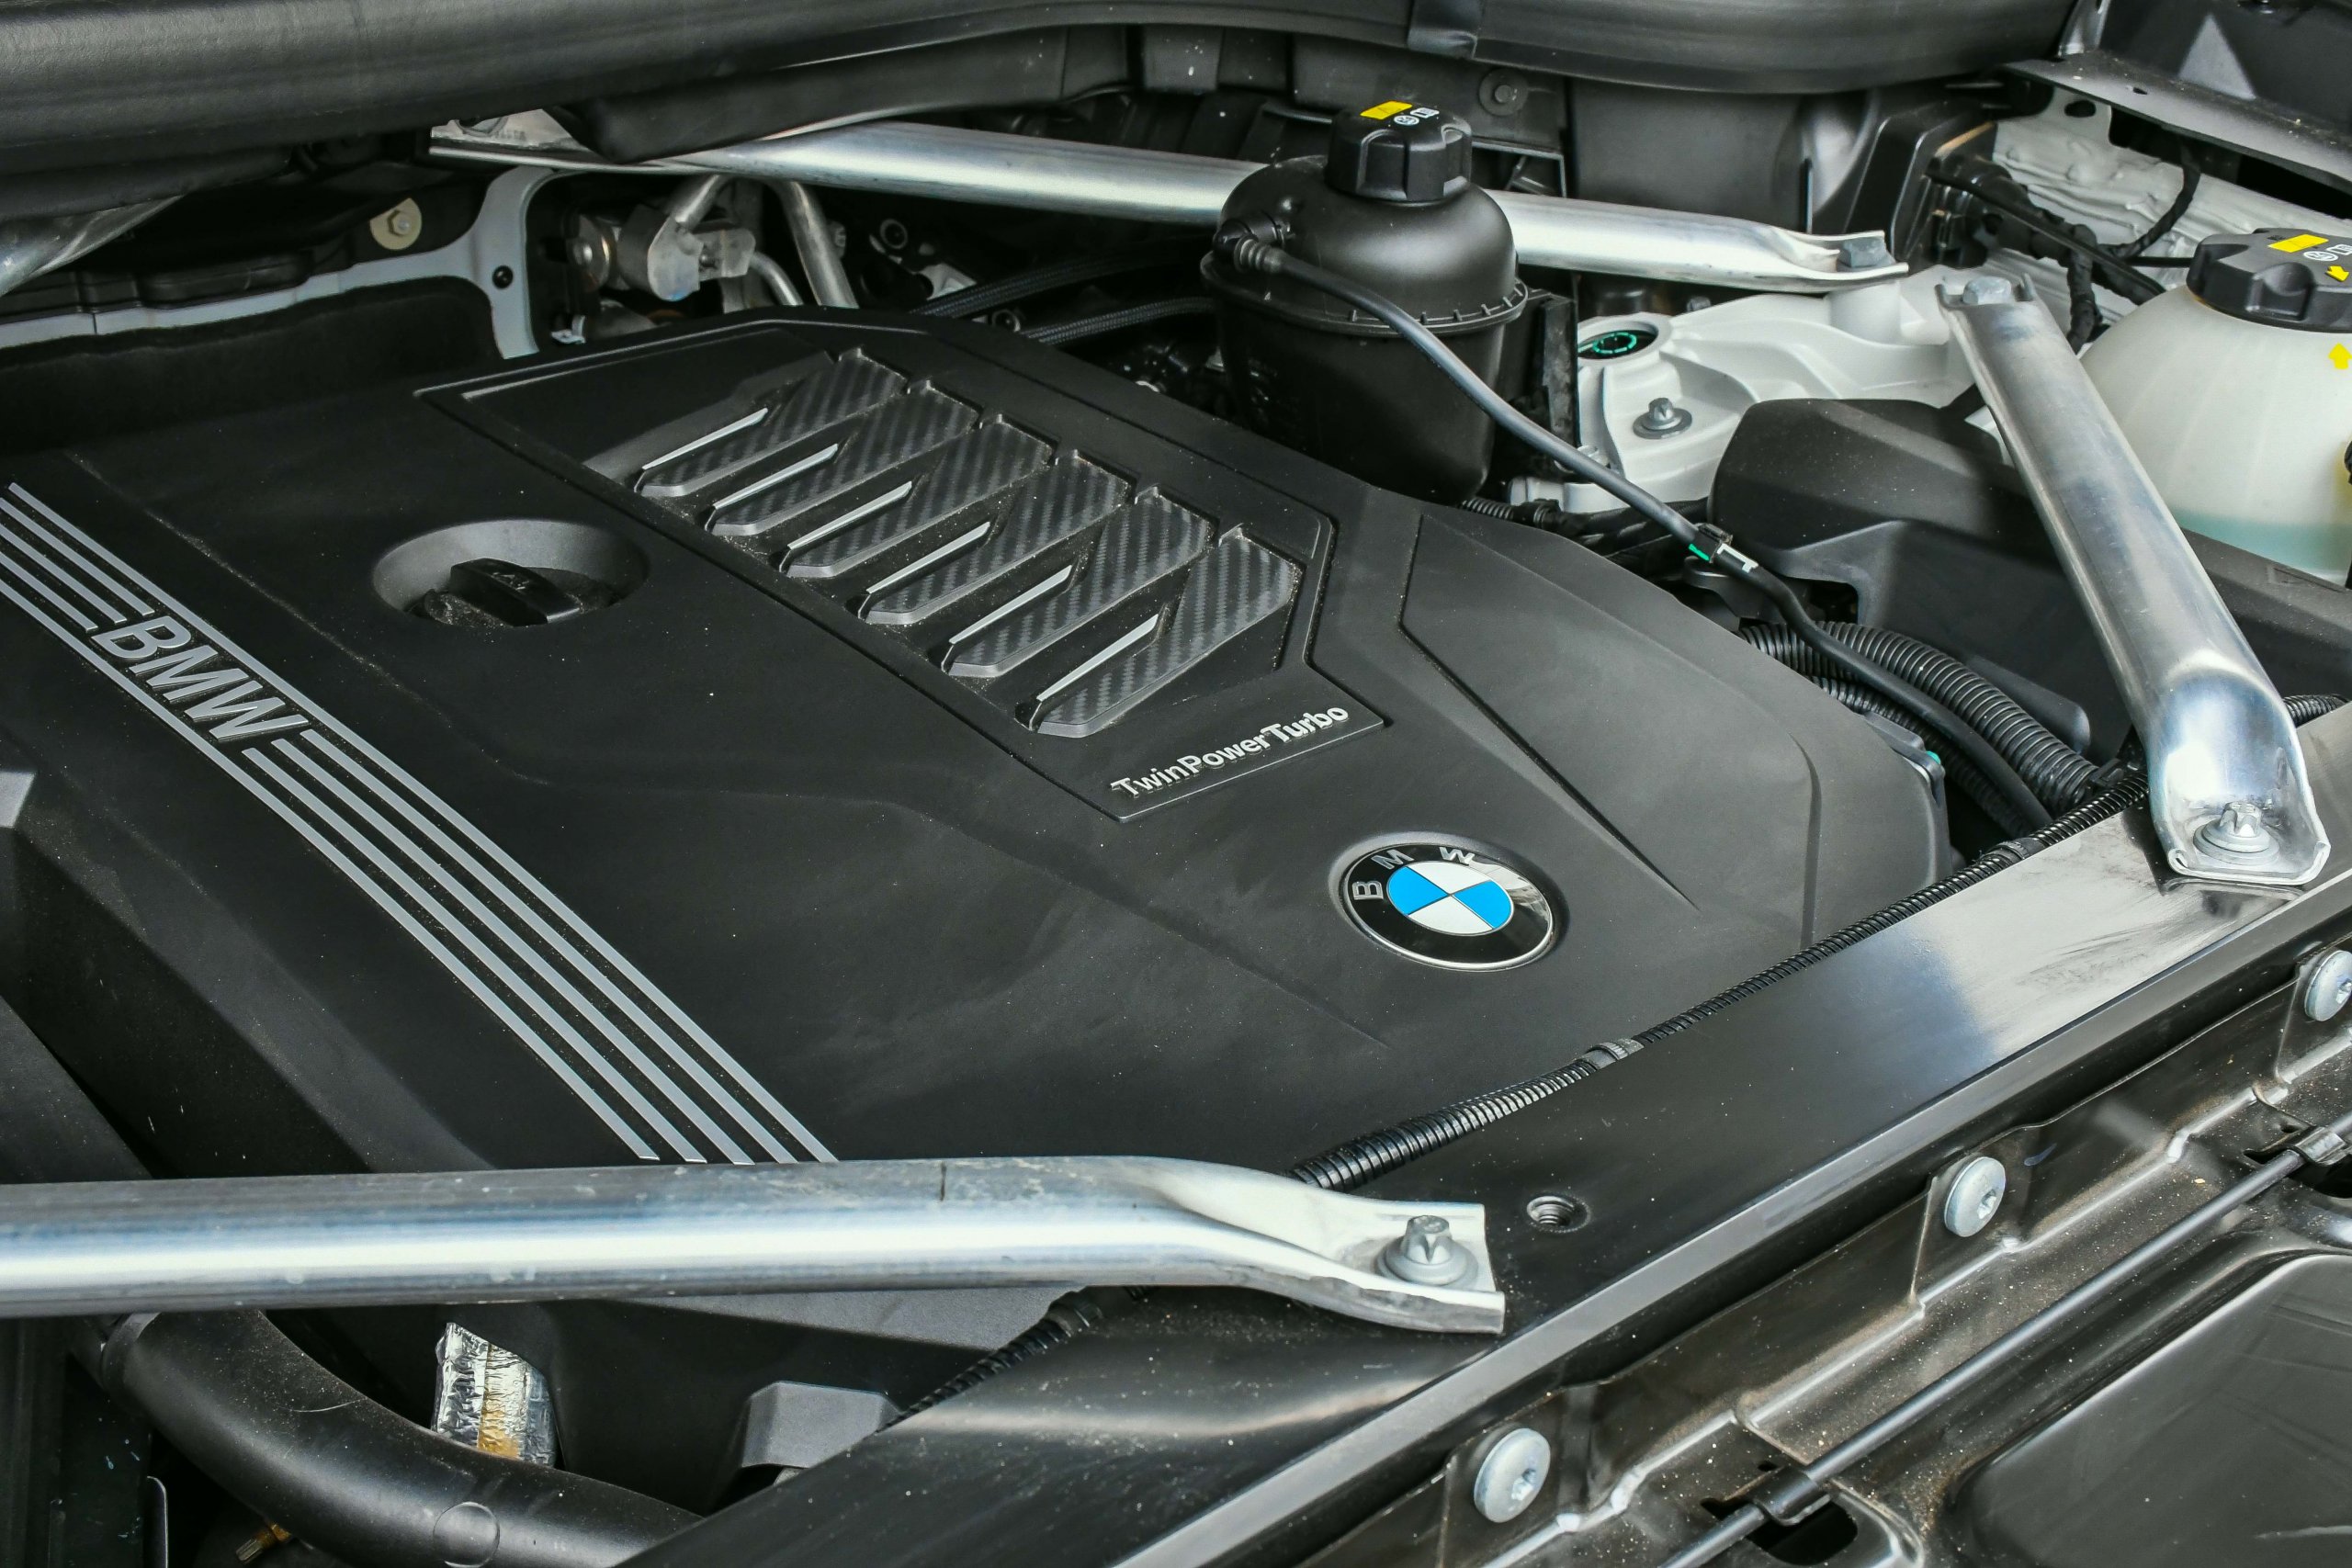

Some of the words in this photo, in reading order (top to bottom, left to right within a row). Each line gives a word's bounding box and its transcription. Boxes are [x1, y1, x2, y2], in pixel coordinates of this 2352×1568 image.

[91, 615, 309, 740] BMW
[1111, 707, 1349, 796] TwinPowerTurbo
[1352, 847, 1476, 900] BMW
